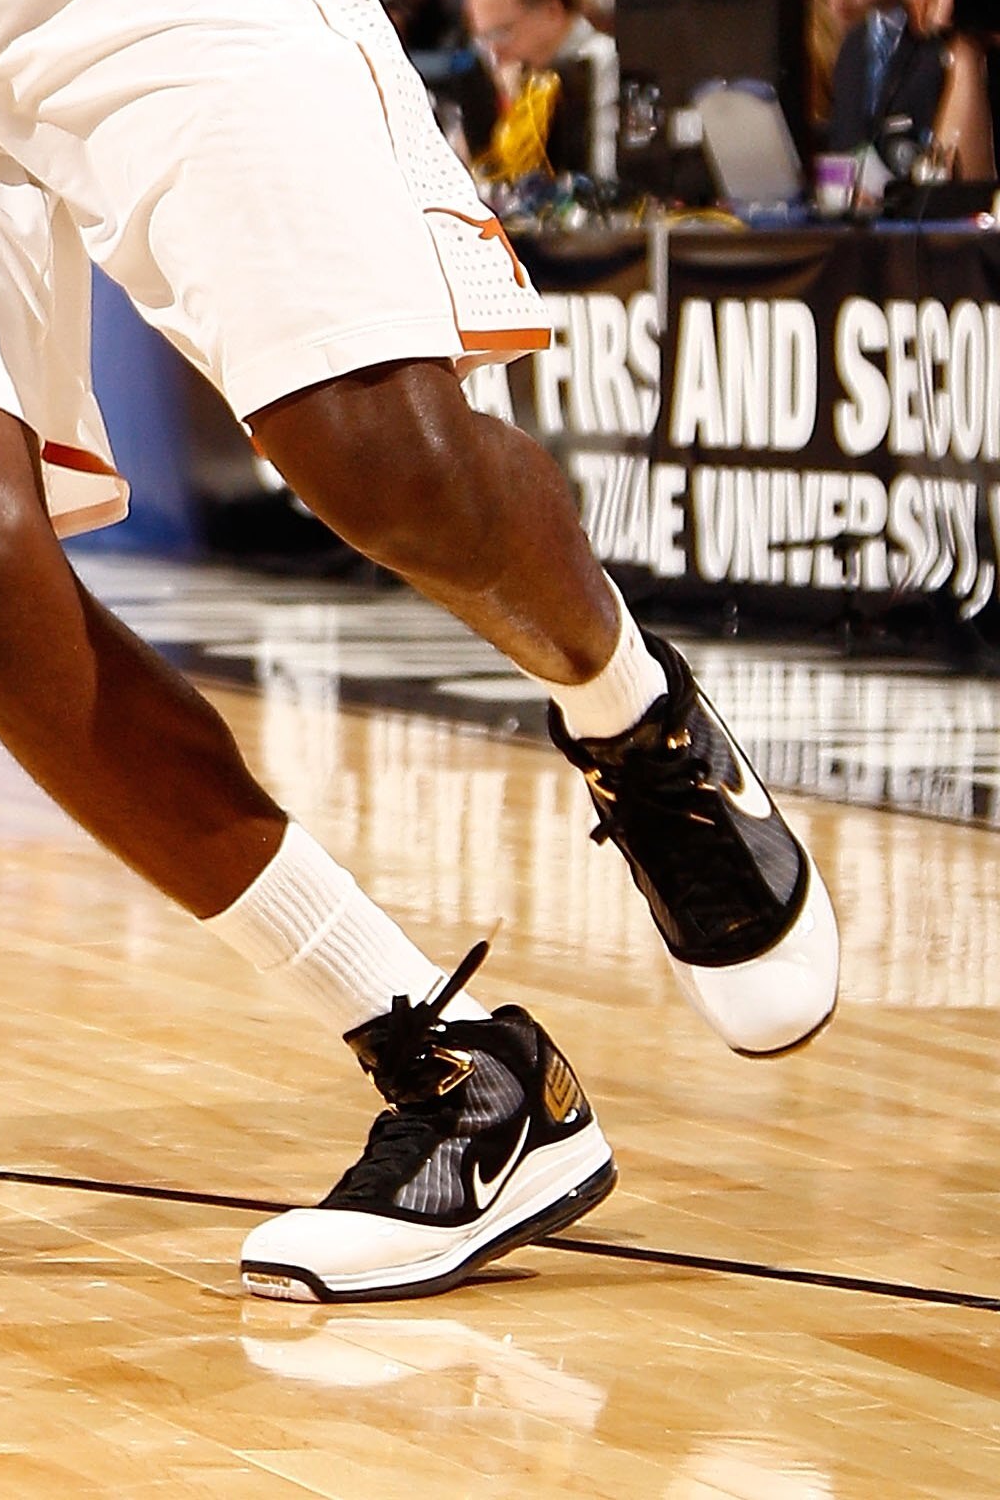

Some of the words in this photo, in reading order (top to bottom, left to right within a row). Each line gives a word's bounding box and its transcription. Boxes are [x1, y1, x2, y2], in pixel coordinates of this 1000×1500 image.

[534, 292, 661, 436] FIRS
[669, 299, 818, 451] AND
[569, 452, 687, 578] TULAE
